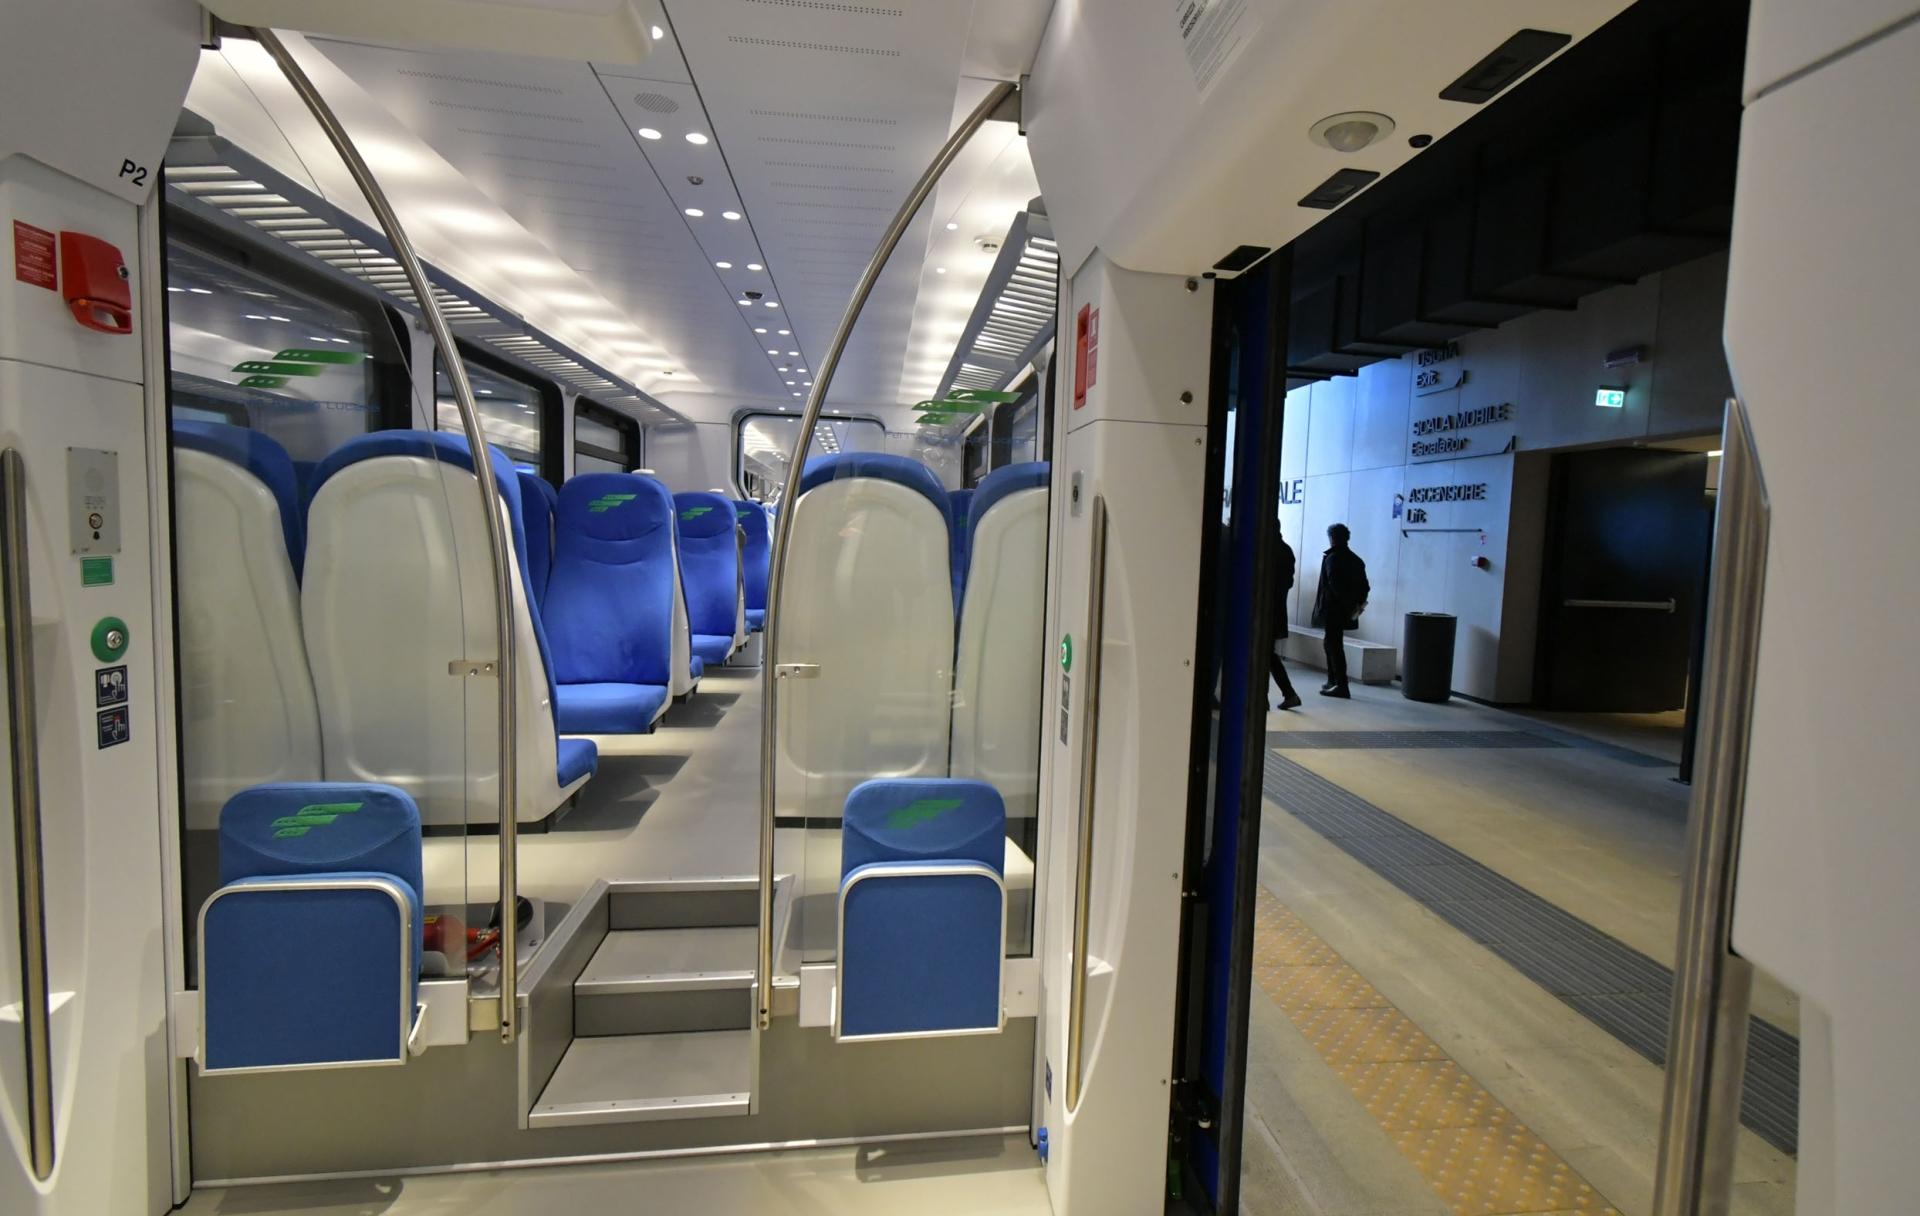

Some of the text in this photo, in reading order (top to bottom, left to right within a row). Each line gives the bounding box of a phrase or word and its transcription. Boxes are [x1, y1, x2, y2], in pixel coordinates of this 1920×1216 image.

[119, 158, 148, 187] P2
[1416, 369, 1439, 389] Exit
[1413, 402, 1513, 436] SCALA MOBILE
[1411, 437, 1469, 457] Escalator
[1408, 482, 1487, 503] ASCENSORE
[1406, 508, 1428, 524] Lift
